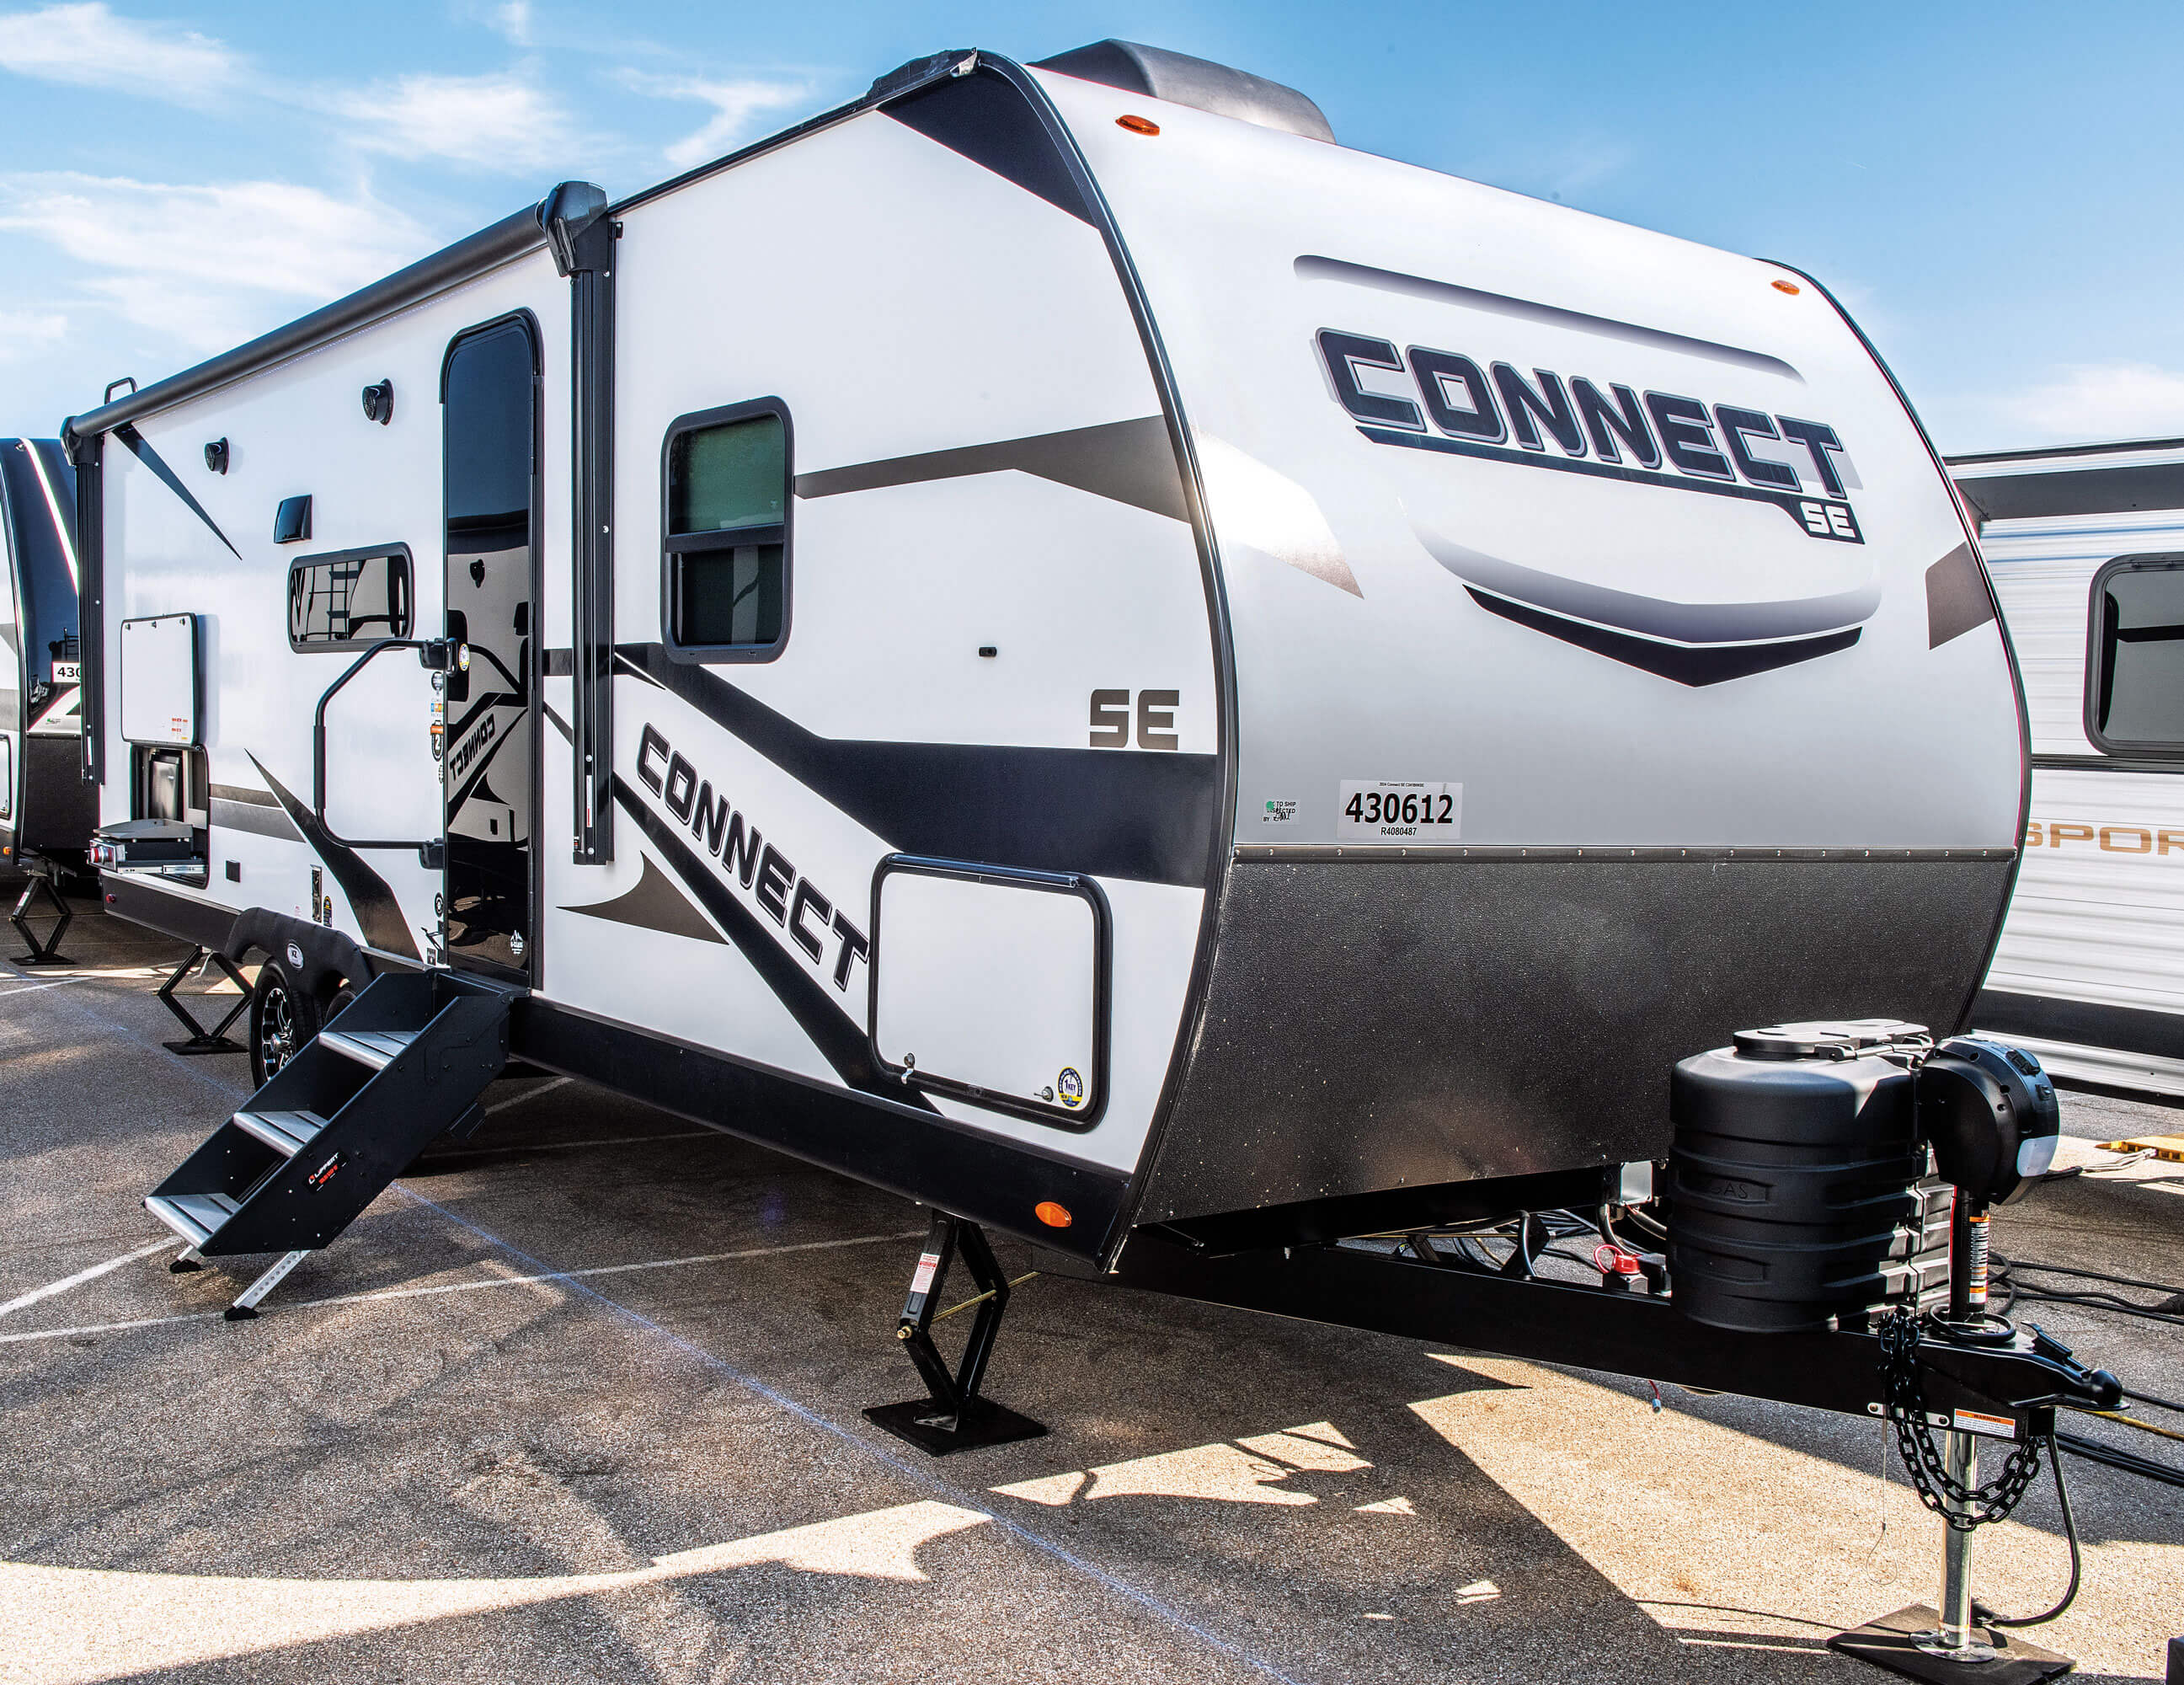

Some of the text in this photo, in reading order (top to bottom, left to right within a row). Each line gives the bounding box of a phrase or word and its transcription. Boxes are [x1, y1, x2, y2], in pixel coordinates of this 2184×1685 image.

[1315, 327, 1849, 500] CONNECT
[1800, 501, 1856, 538] SE
[1089, 689, 1180, 751] SE
[1345, 792, 1454, 824] 430612
[1380, 826, 1418, 836] R4080487
[637, 722, 870, 992] CONNECT
